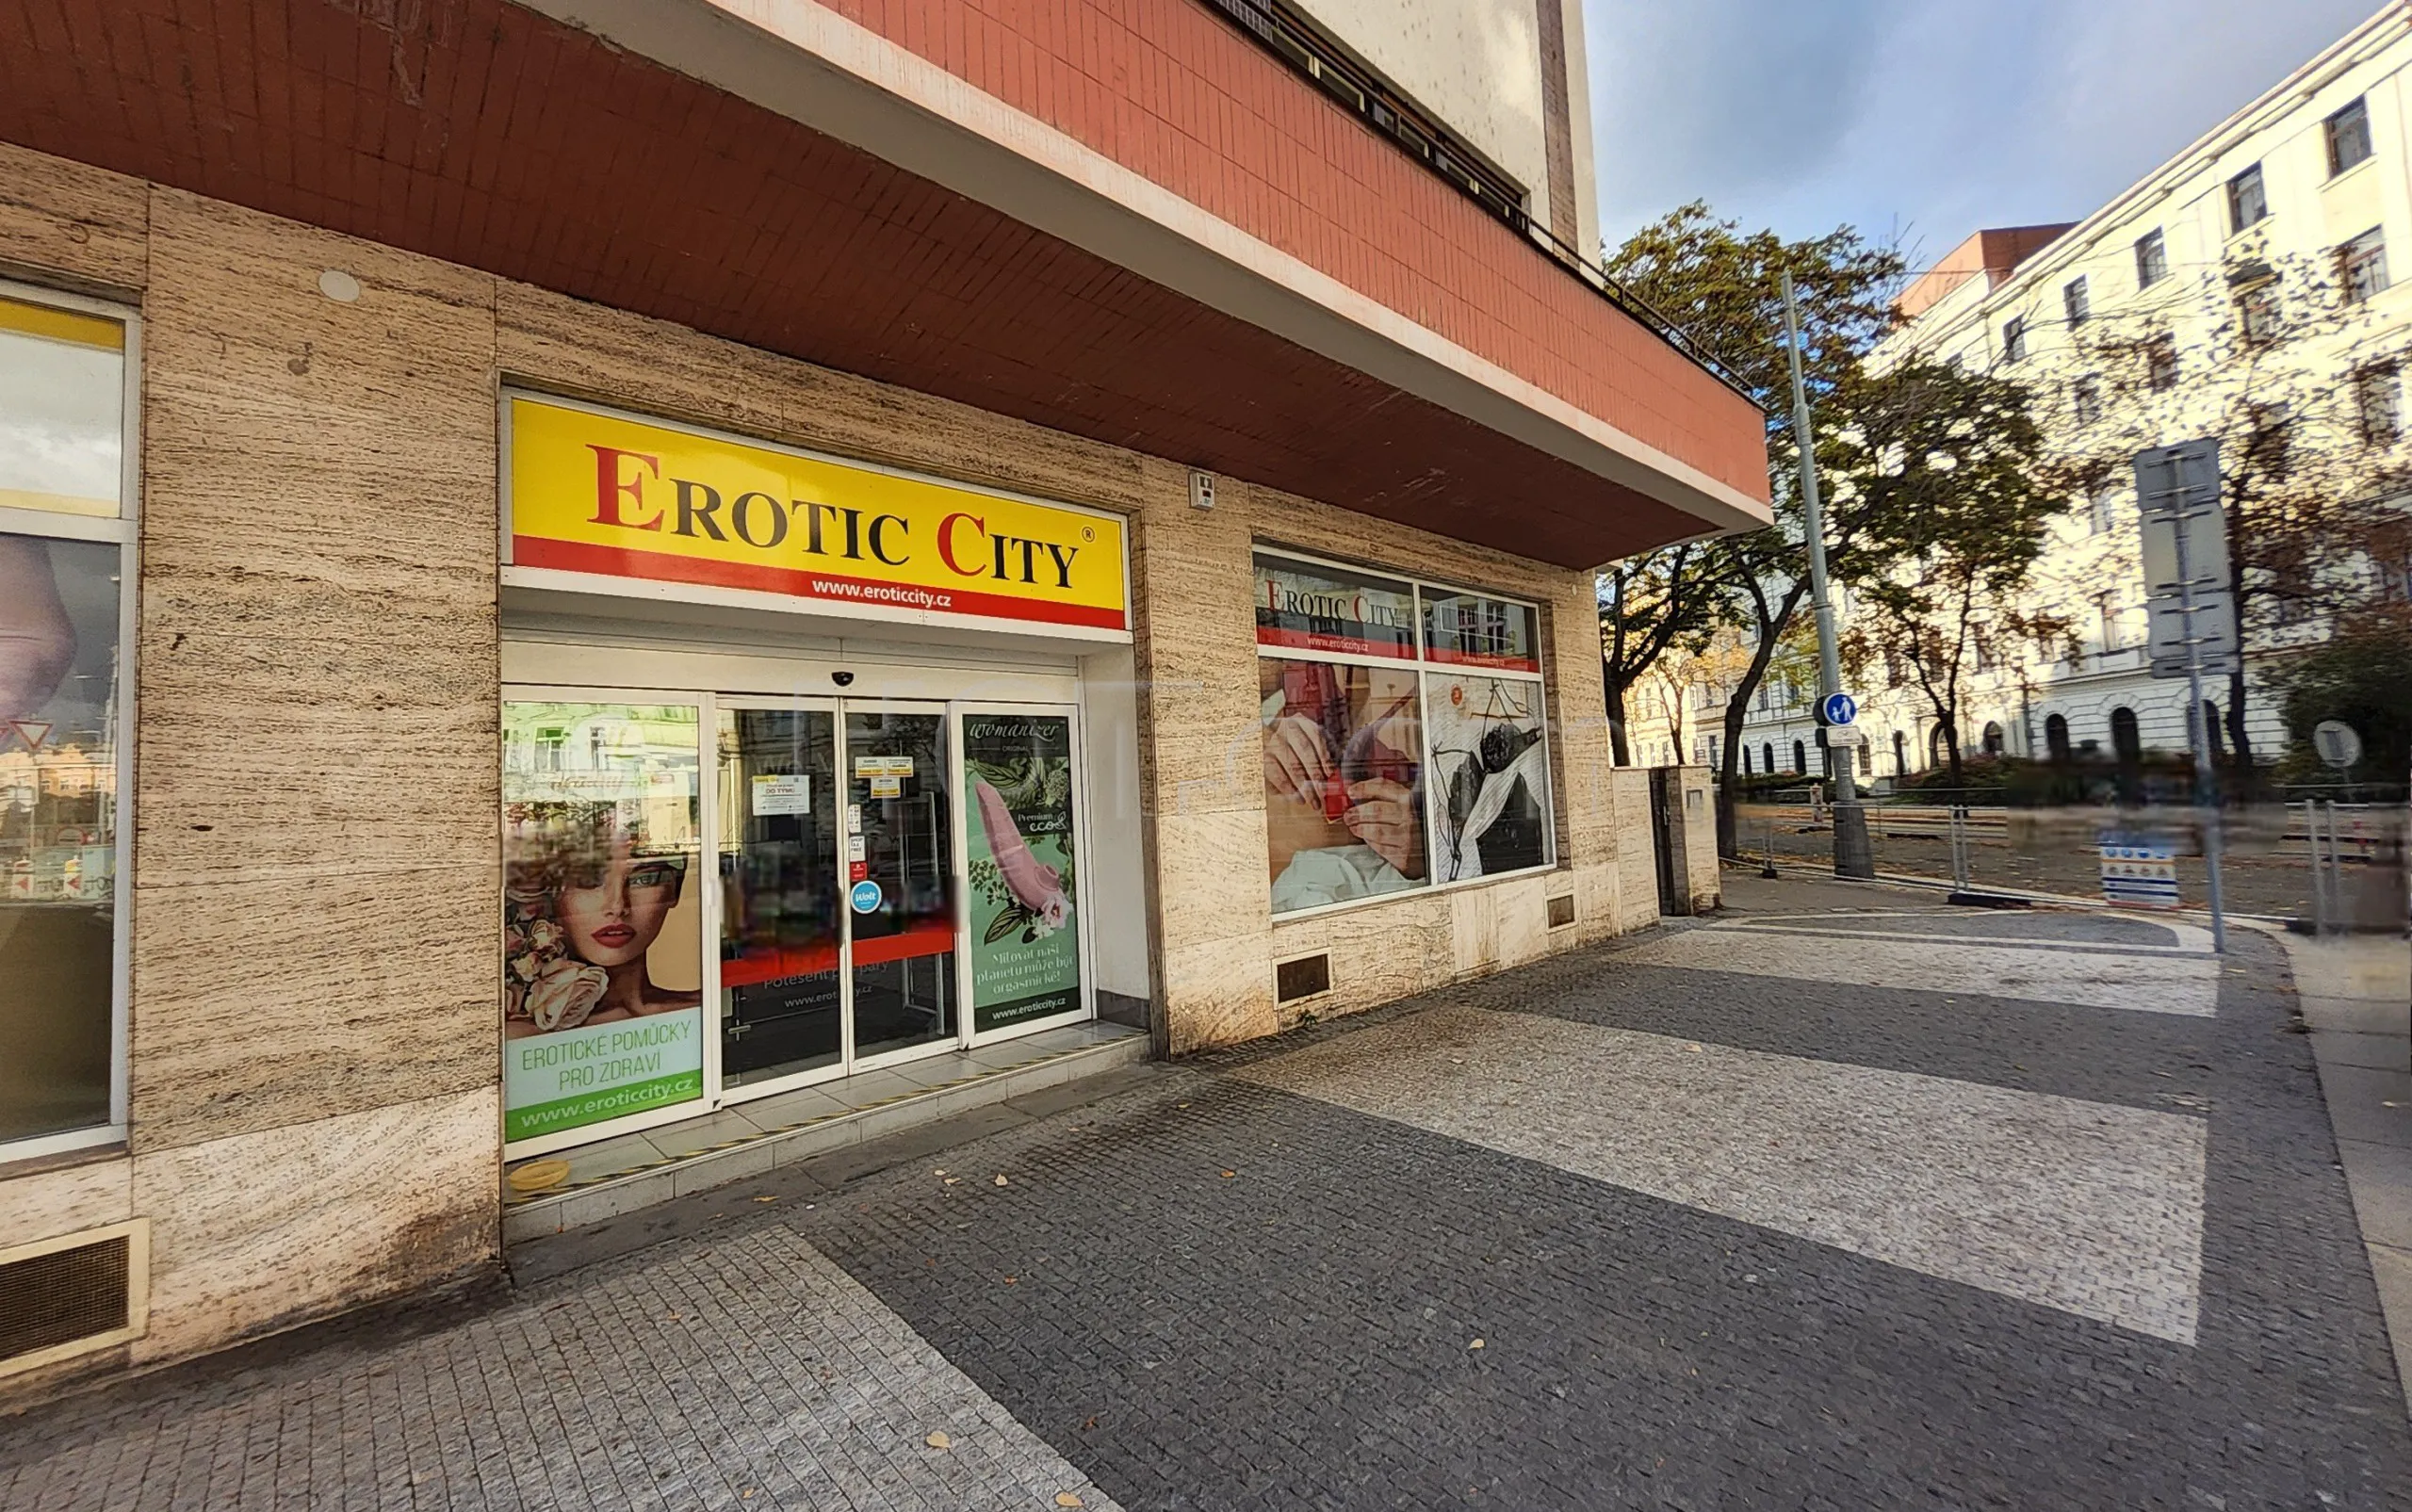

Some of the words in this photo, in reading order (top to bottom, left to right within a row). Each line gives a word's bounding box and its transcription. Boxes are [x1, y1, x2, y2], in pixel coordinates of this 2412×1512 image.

[585, 443, 911, 565] EROTIC
[936, 512, 1080, 590] CITY
[811, 579, 952, 609] www.eroticcity.cz
[1265, 579, 1347, 622] EROTIC
[1353, 593, 1399, 627] CITY
[1306, 636, 1370, 653] www.eroticcity.cz
[1018, 812, 1053, 822] Premium
[855, 891, 876, 902] Wolt
[784, 984, 872, 1008] www.eroty.cz
[991, 997, 1067, 1020] www.eroticcity.cz
[521, 1032, 609, 1071] EROTICKÉ
[611, 1019, 692, 1053] POMŮCKY
[559, 1065, 594, 1092] PRO
[599, 1048, 661, 1083] ZDRAVÍ
[520, 1078, 693, 1129] www.eroticcity.cz
